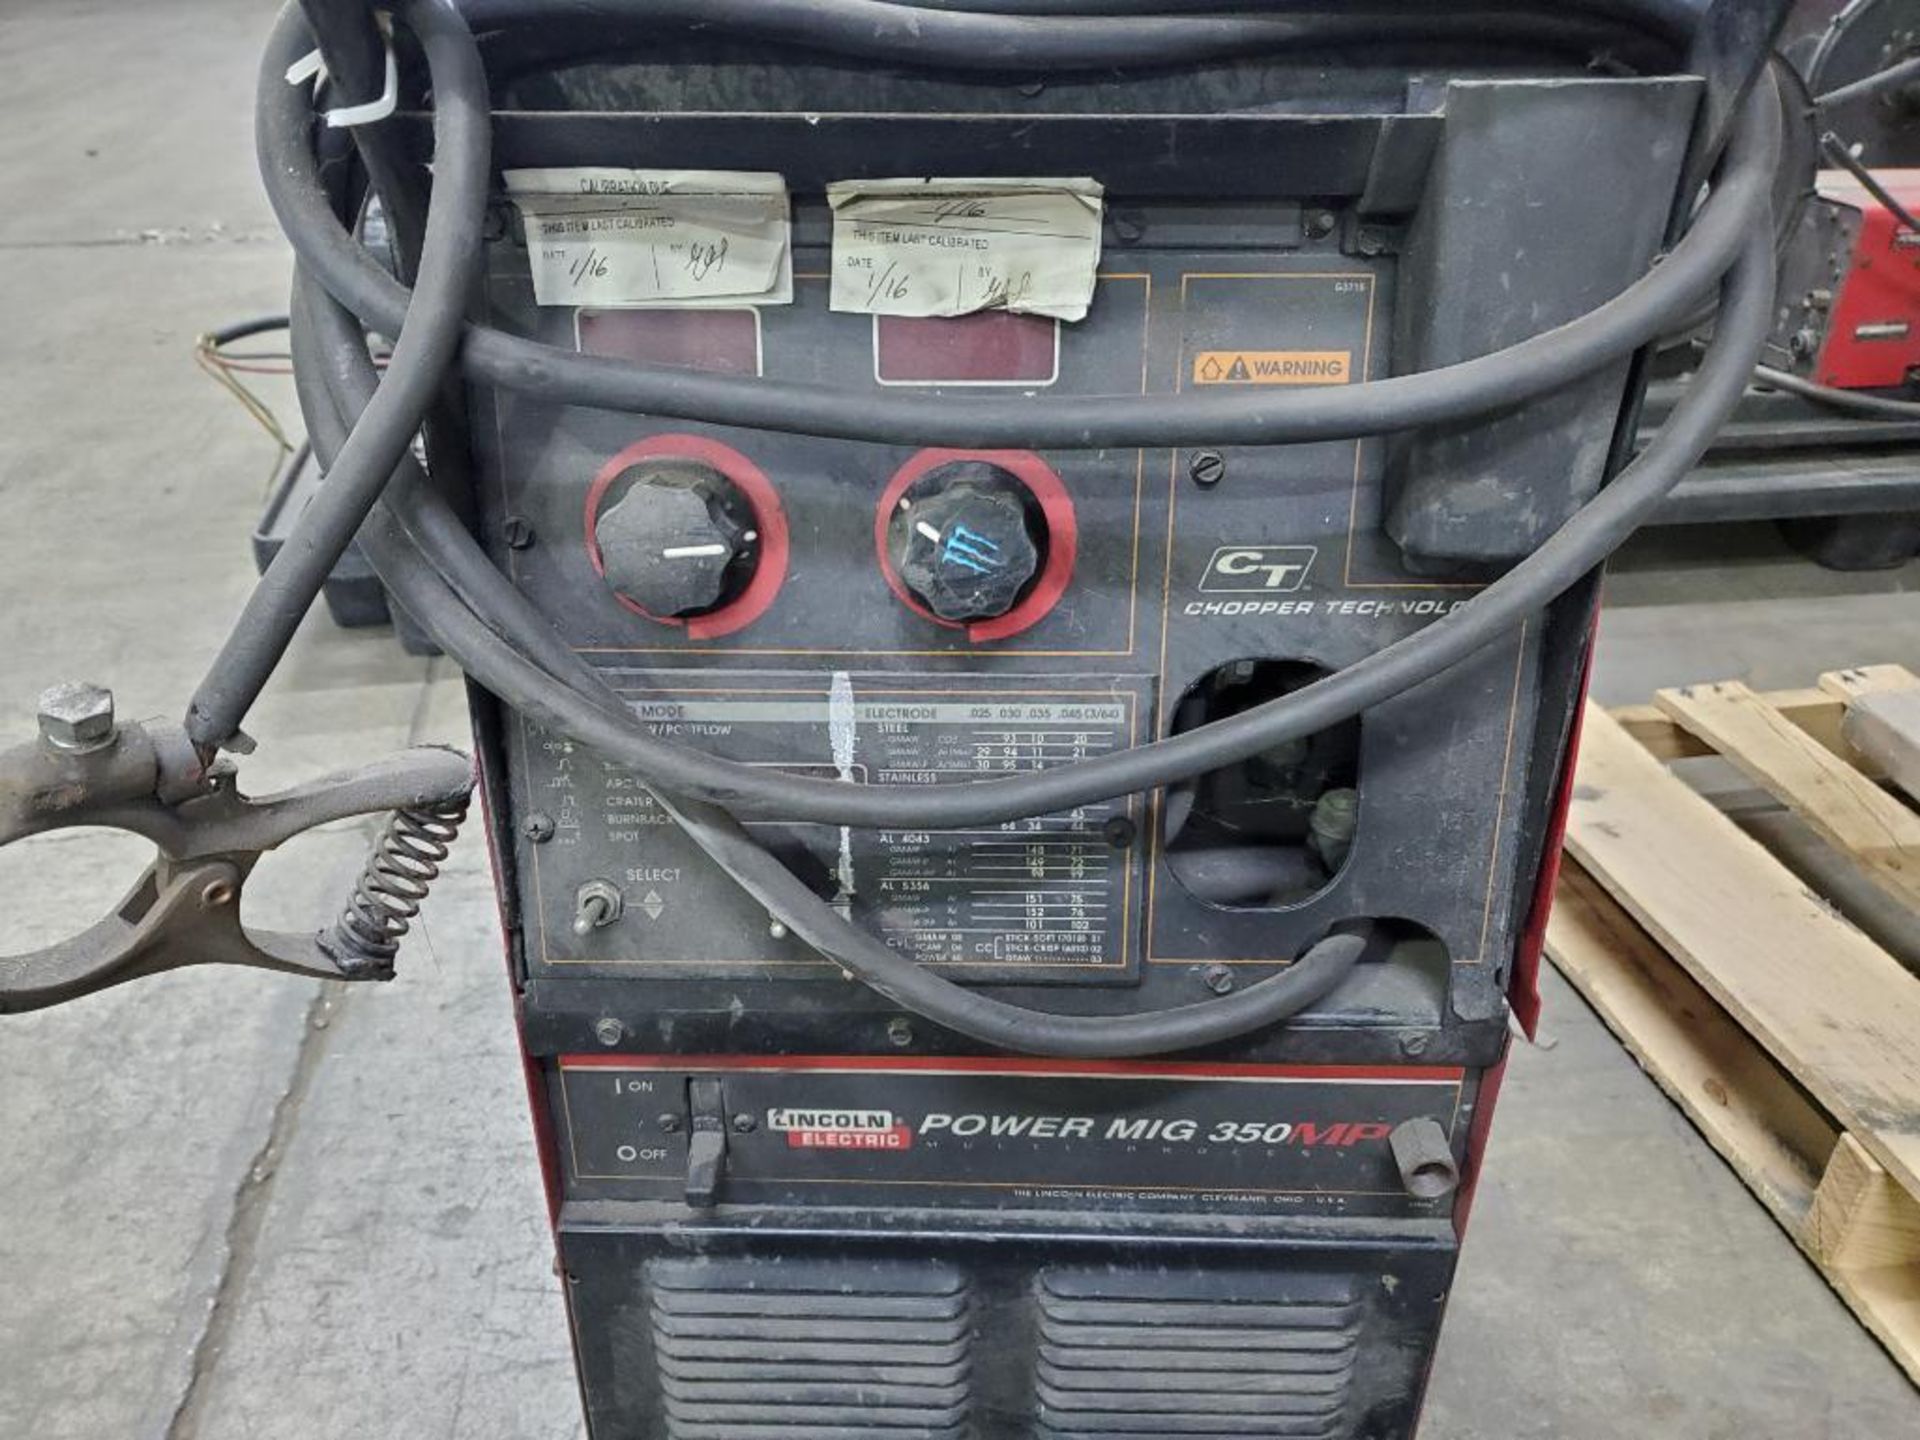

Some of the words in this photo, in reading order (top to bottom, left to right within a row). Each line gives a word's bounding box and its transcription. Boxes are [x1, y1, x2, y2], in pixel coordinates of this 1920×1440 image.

[853, 229, 875, 241] THIS
[876, 230, 901, 243] ITEM
[928, 234, 989, 250] CALIBRATED
[568, 248, 608, 286] 1/16
[847, 256, 873, 268] DATE
[866, 260, 909, 306] 1/16
[1253, 360, 1343, 377] WARNING
[1215, 551, 1303, 587] CT
[1184, 601, 1313, 616] CHOPPER
[641, 705, 686, 718] MODE
[864, 707, 938, 719] ELECTRODE
[877, 722, 909, 733] STEEL
[976, 746, 992, 757] 29
[975, 759, 990, 770] 30
[605, 778, 632, 789] ARC
[877, 772, 938, 784] STAINLESS
[608, 831, 640, 842] SPOT
[880, 834, 895, 844] AL
[626, 868, 681, 882] SELECT
[880, 881, 895, 891] AL
[1025, 894, 1043, 904] 151
[974, 943, 993, 953] CC
[628, 1081, 653, 1092] ON
[773, 1110, 885, 1128] LINCOLN
[917, 1113, 1095, 1138] POWER
[1104, 1117, 1200, 1142] MIG
[801, 1131, 901, 1147] ELECTRIC
[639, 1148, 668, 1160] OFF
[1035, 1190, 1083, 1198] LINCOLN
